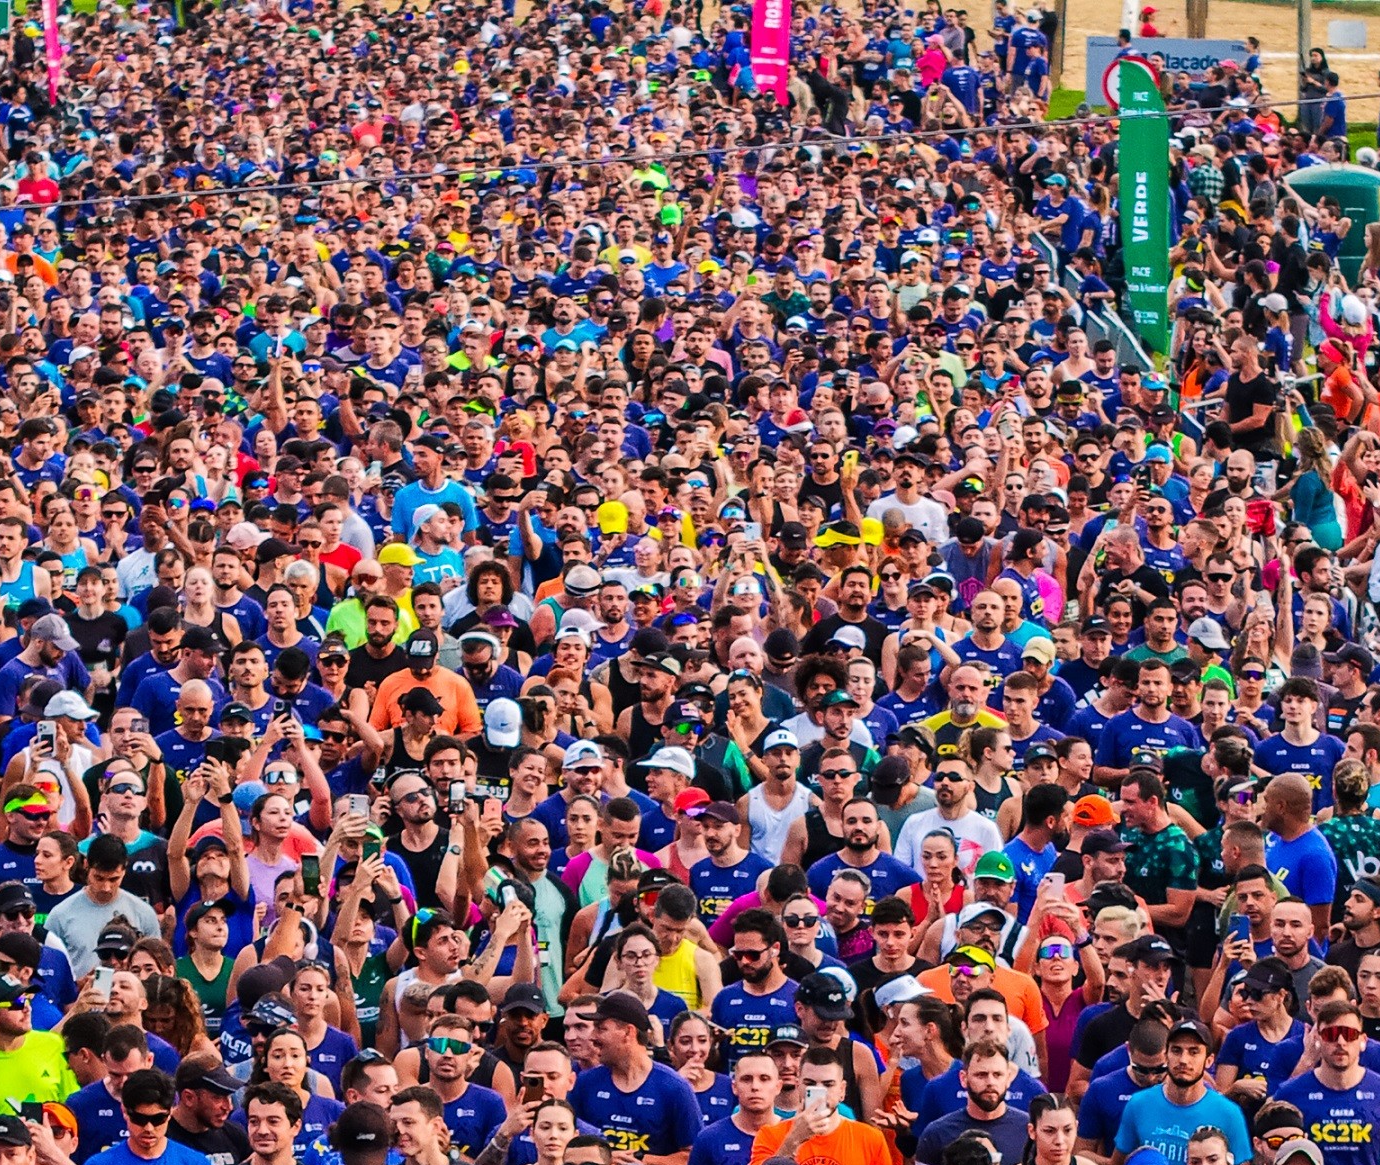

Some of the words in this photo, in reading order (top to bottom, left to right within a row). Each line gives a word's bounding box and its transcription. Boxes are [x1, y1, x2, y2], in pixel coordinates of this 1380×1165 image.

[764, 0, 782, 29] ROS
[1133, 172, 1148, 243] VERDE
[602, 1129, 649, 1151] C21K
[1310, 1123, 1371, 1144] SC21K
